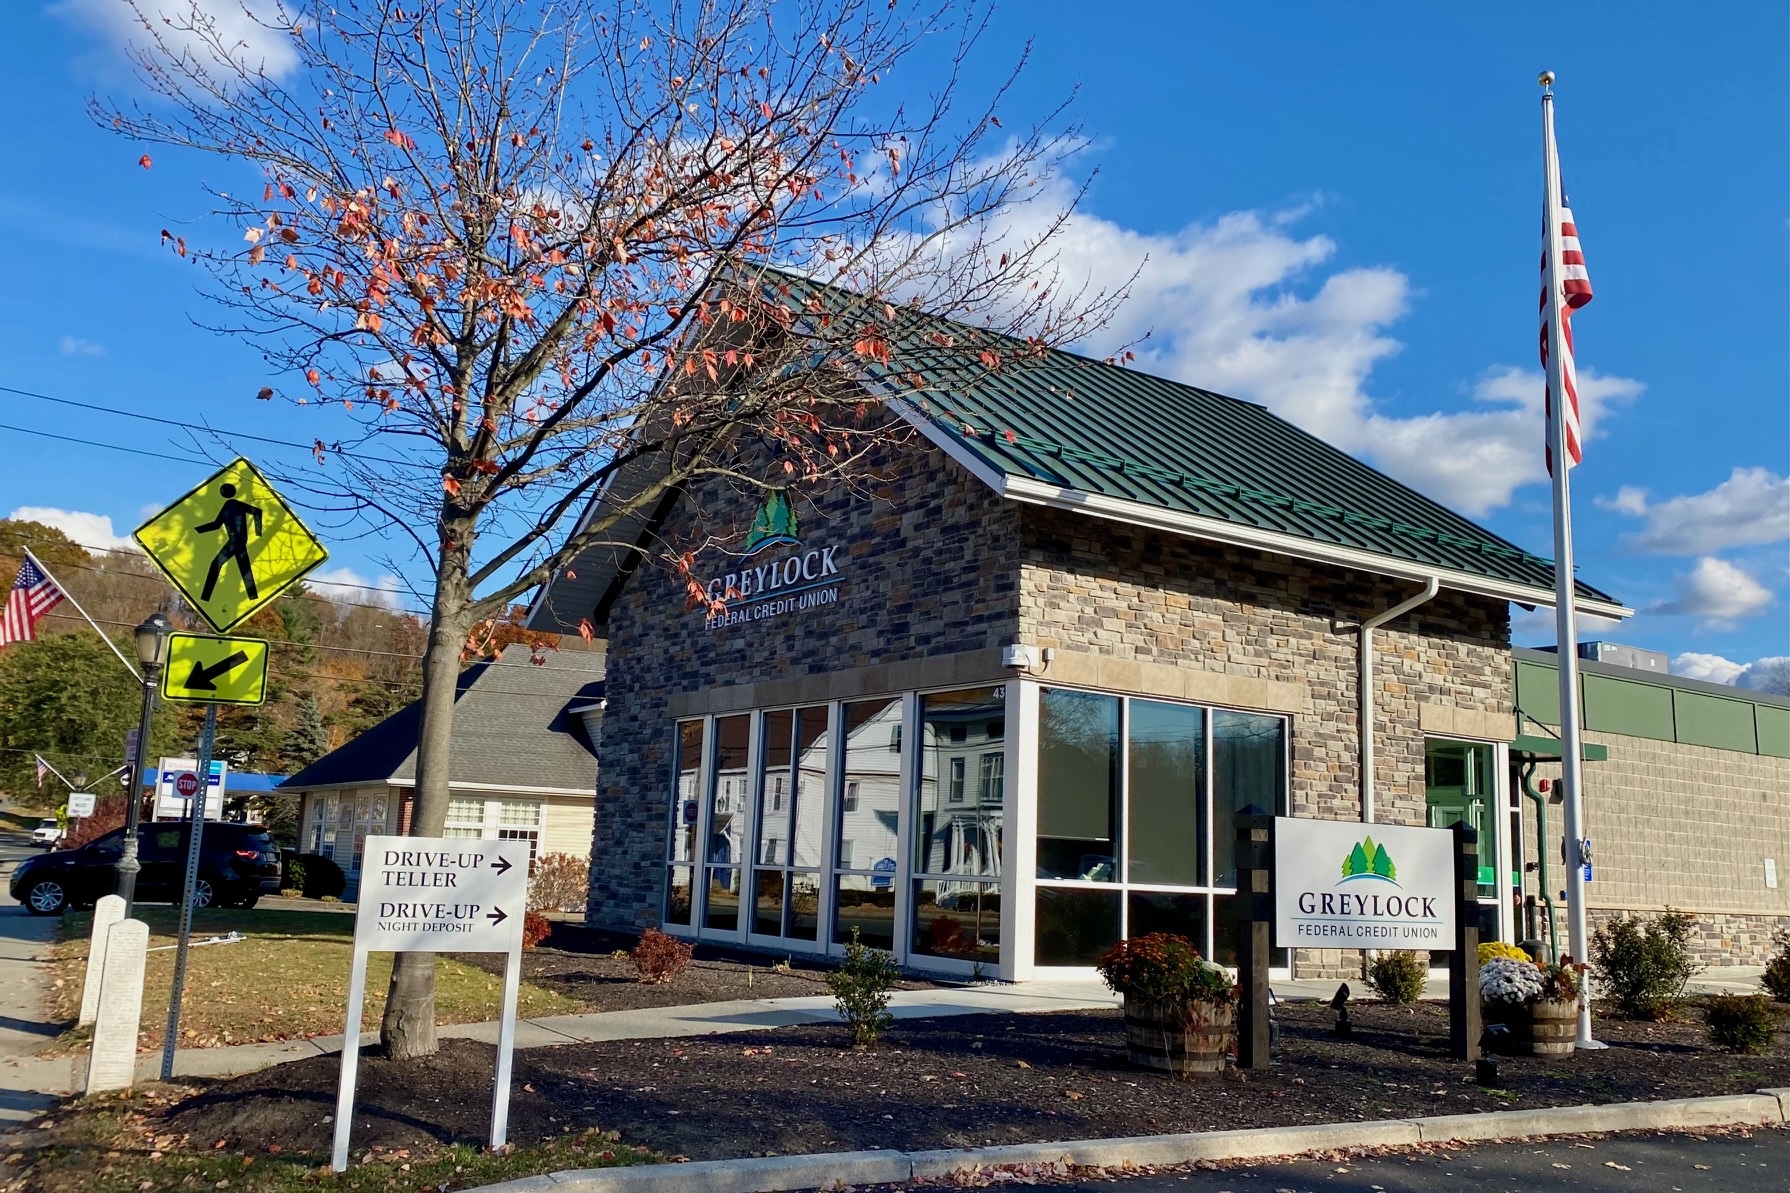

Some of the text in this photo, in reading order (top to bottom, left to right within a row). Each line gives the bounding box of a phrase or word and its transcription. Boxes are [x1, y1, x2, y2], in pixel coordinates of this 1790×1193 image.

[707, 545, 839, 602] GREYLOCK
[705, 587, 838, 631] FEDERAL CREDIT UNION
[178, 779, 197, 790] STOP
[384, 850, 484, 868] DRIVE-UP
[382, 871, 457, 887] TELLER
[379, 902, 480, 919] DRIVE-UP
[1298, 892, 1437, 918] GREYLOCK
[377, 921, 475, 933] NIGHT DEPOSIT
[1298, 924, 1438, 939] FEDERAL CREDIT UNION
